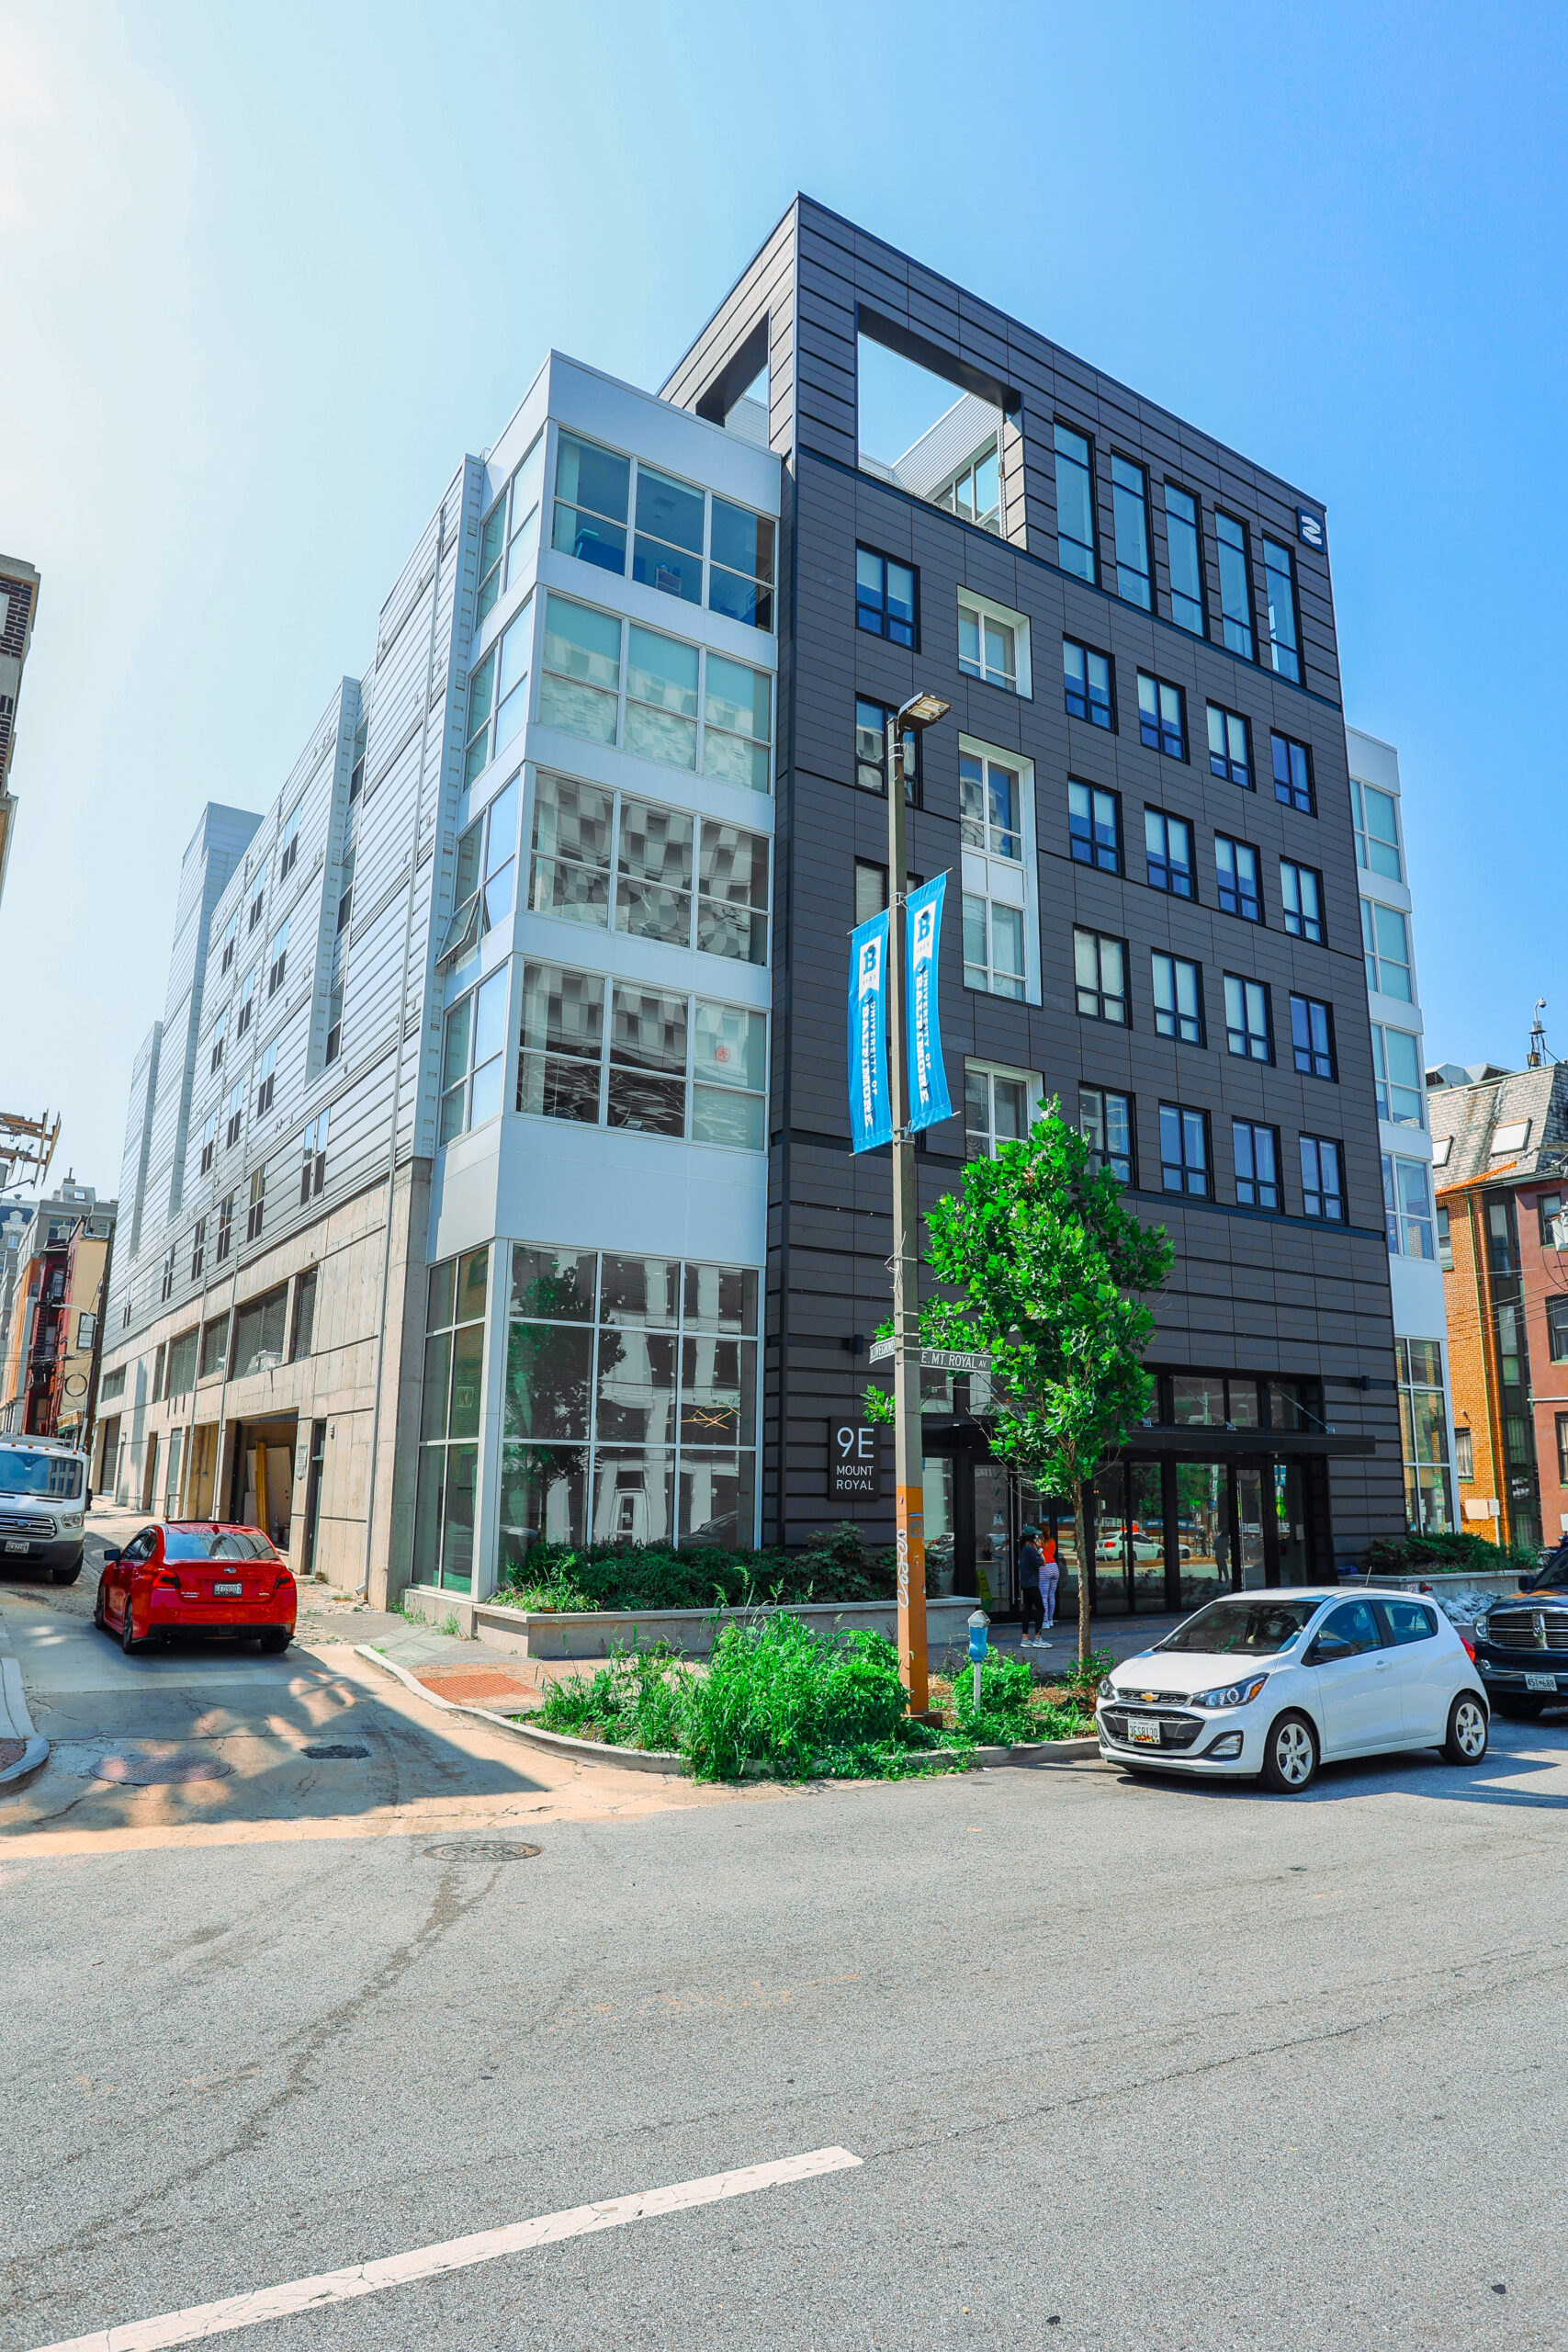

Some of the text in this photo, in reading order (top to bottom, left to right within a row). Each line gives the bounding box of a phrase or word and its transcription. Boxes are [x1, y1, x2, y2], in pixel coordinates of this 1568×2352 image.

[916, 973, 929, 1103] BALTIMORE
[862, 1004, 873, 1127] BALTIMORE
[925, 1053, 931, 1069] OF
[871, 1080, 877, 1095] OF
[921, 1351, 930, 1363] E.
[931, 1352, 946, 1365] MT.
[949, 1354, 976, 1369] ROYAL
[837, 1427, 874, 1458] 9E
[836, 1464, 874, 1476] MOUNT
[836, 1479, 874, 1490] ROYAL
